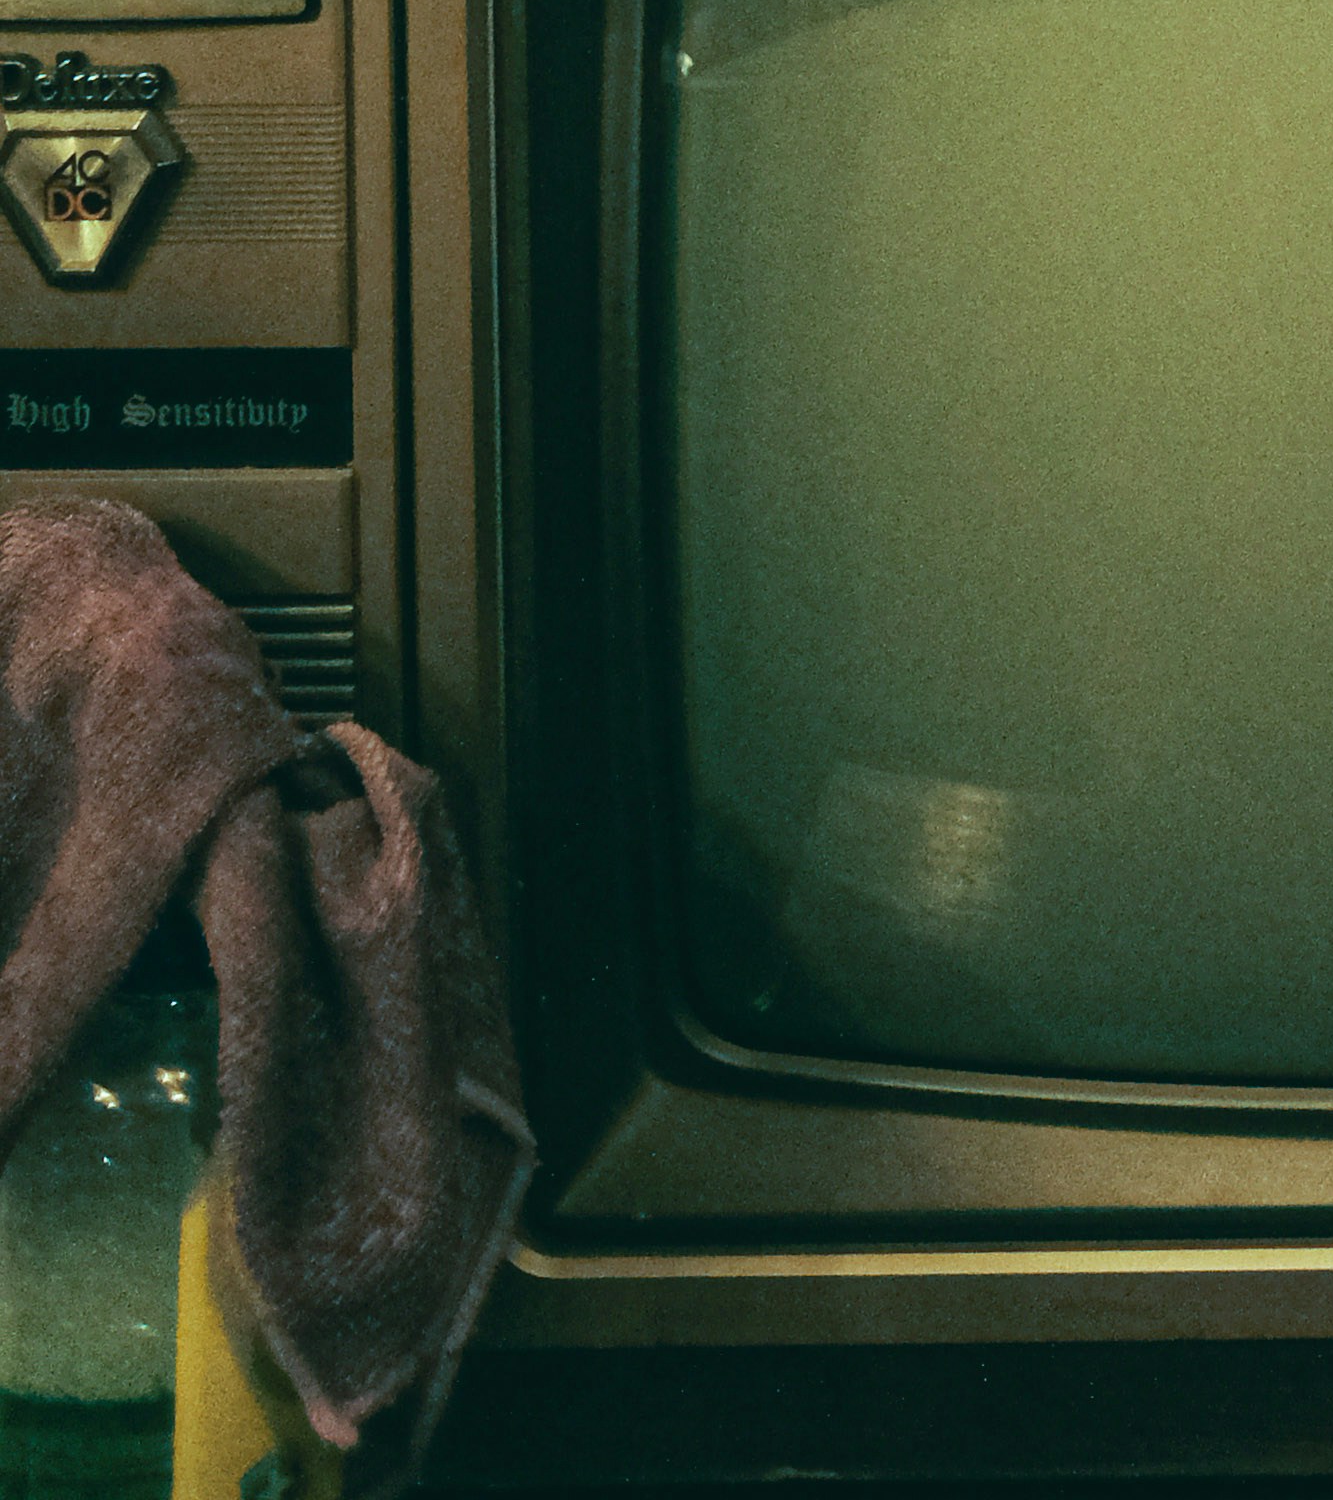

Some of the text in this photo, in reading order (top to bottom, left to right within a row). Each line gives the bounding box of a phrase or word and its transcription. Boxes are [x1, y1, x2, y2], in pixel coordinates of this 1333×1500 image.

[46, 150, 110, 186] AC
[48, 186, 110, 220] DC
[6, 393, 308, 434] High Sensitivity
